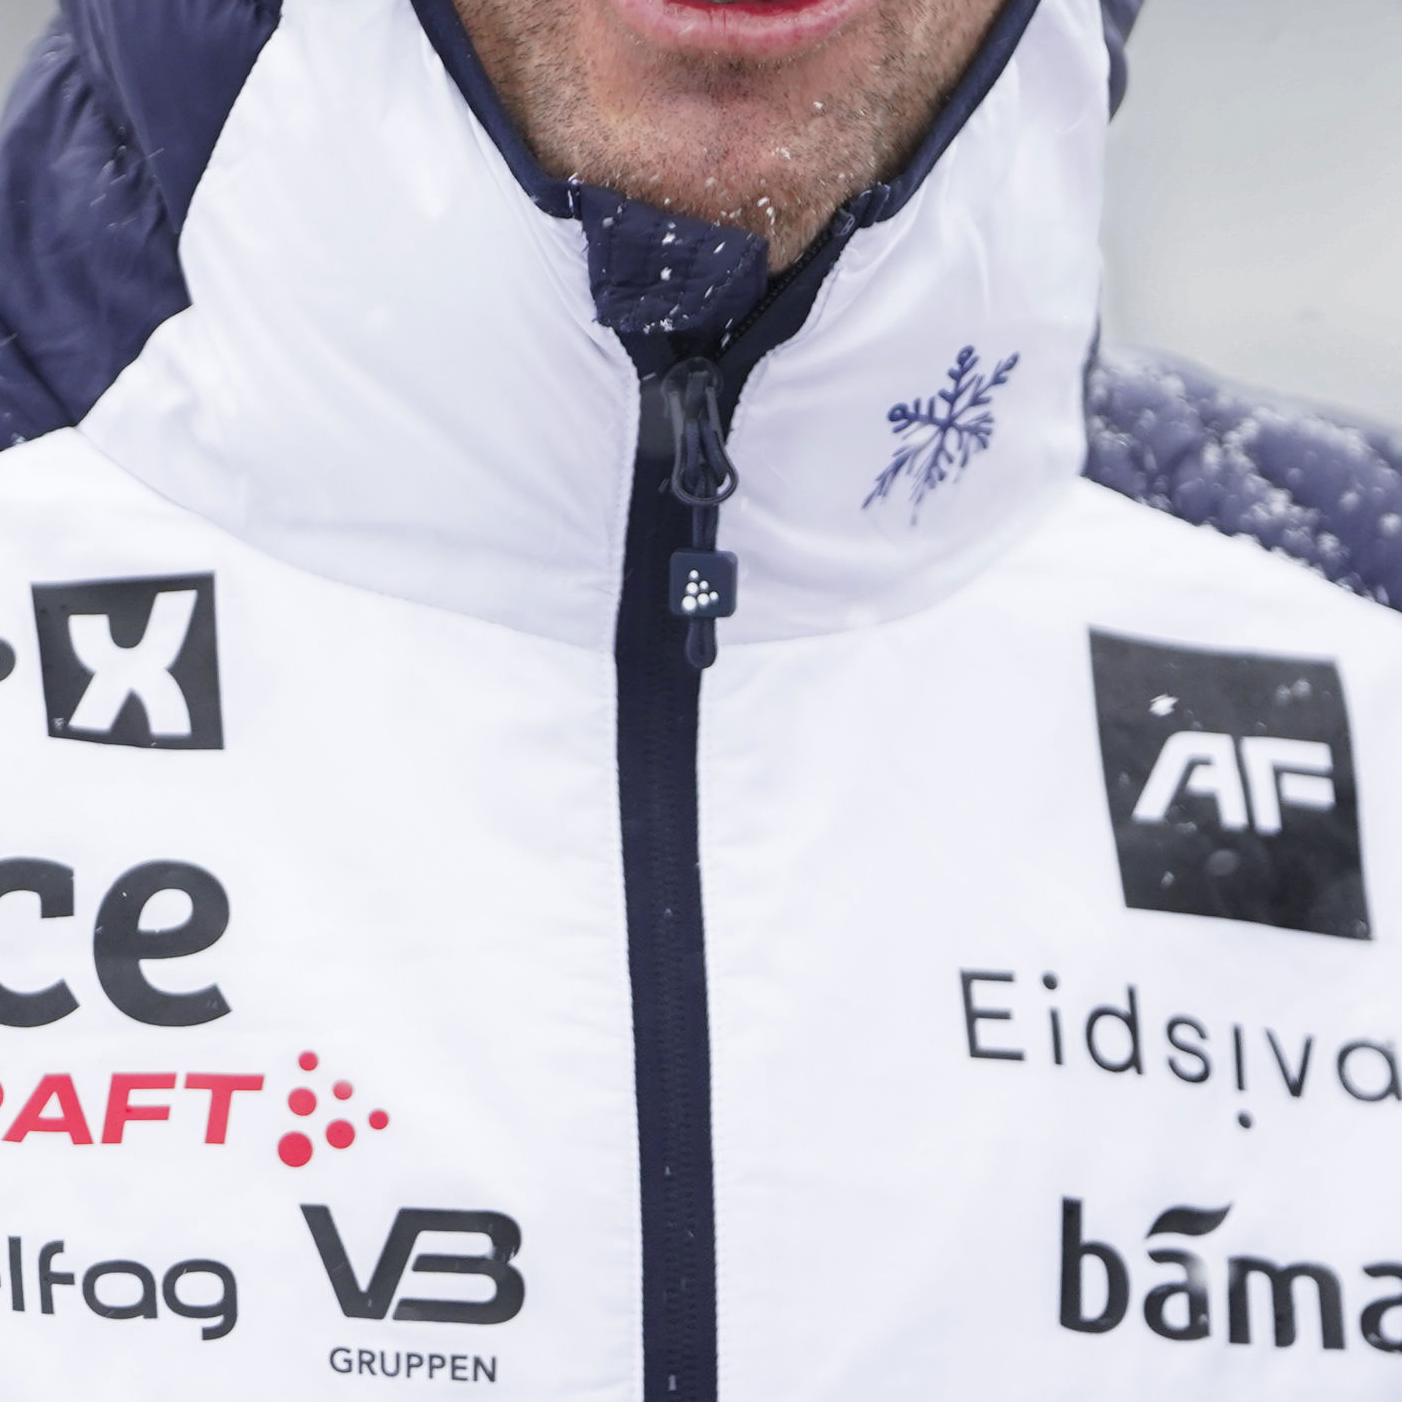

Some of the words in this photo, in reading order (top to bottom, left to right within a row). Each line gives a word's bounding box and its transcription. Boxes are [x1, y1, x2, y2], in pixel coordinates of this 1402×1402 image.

[66, 588, 198, 737] X
[1130, 729, 1337, 837] AF
[299, 1203, 527, 1326] VB
[329, 1346, 497, 1383] GRUPPEN
